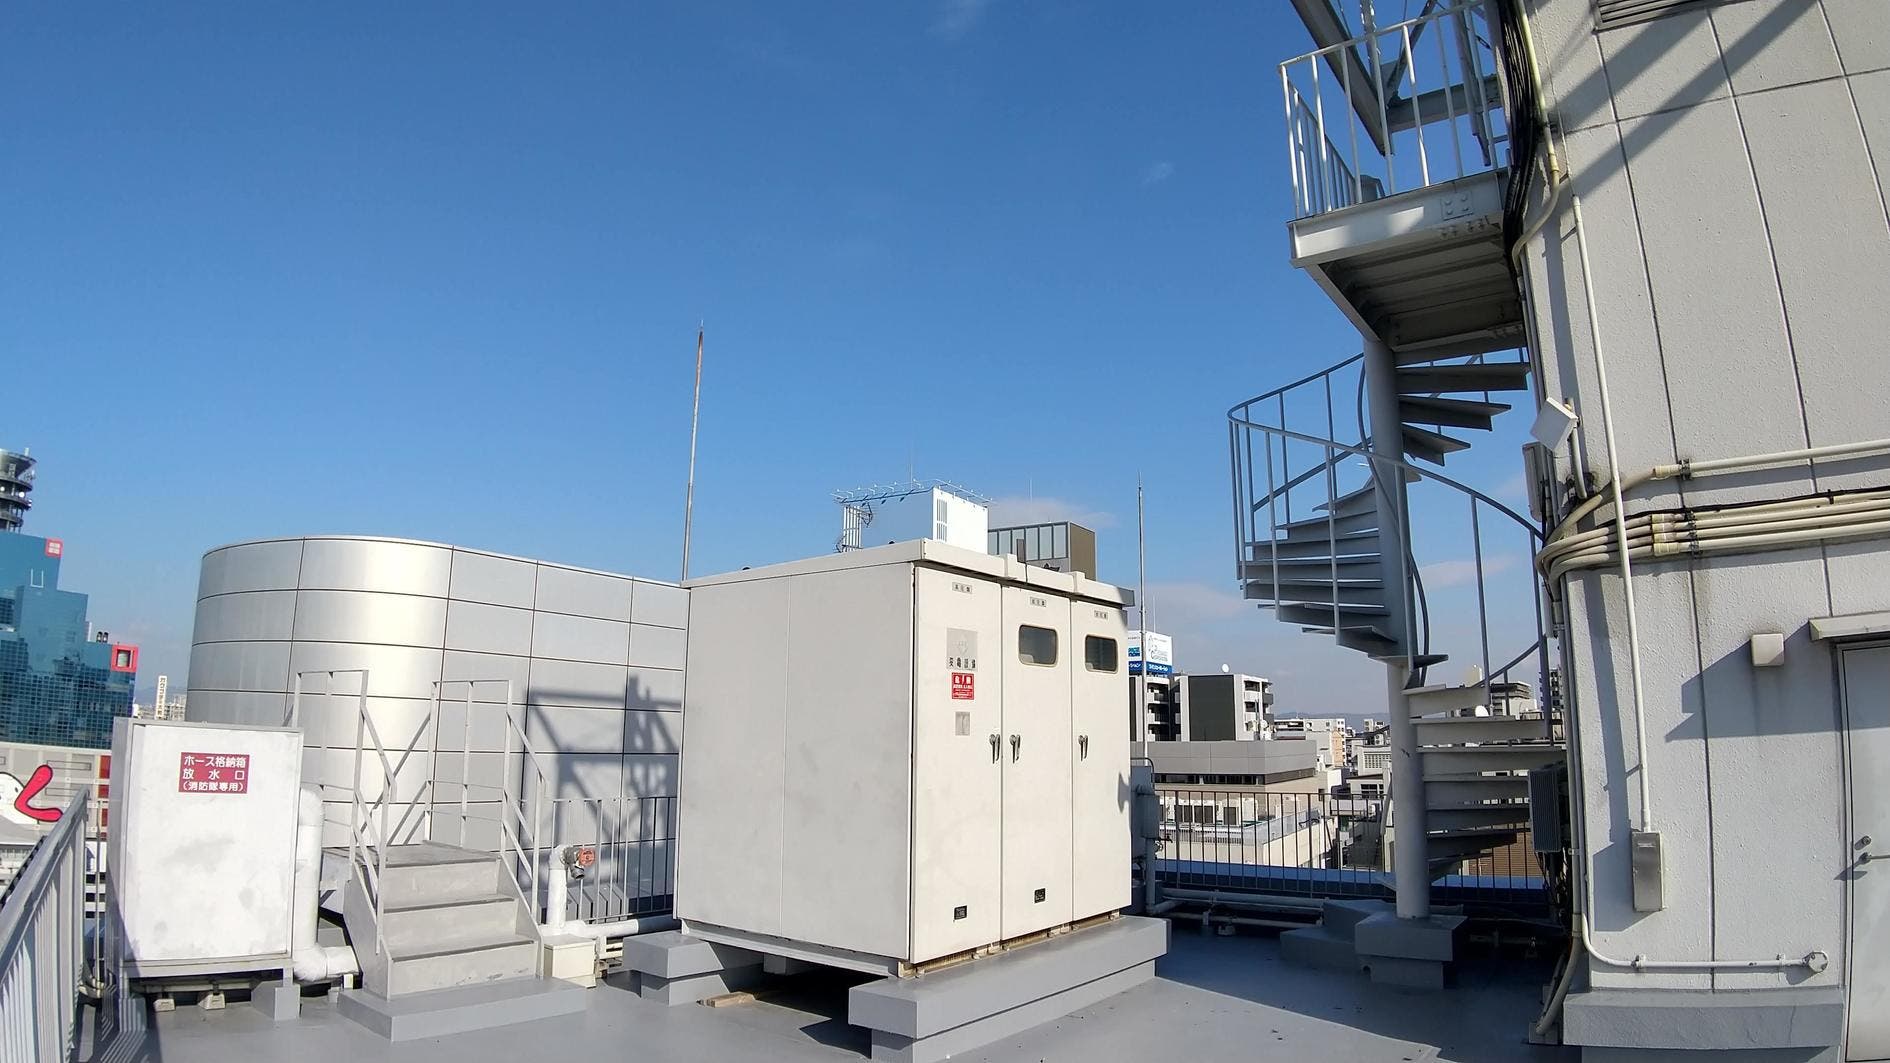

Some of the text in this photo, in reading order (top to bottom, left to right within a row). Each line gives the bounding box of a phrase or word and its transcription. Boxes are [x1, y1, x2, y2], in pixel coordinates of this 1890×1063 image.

[184, 755, 246, 768] ホース格納箱
[183, 768, 245, 780] 放水口
[183, 780, 244, 792] （消防隊専用）
